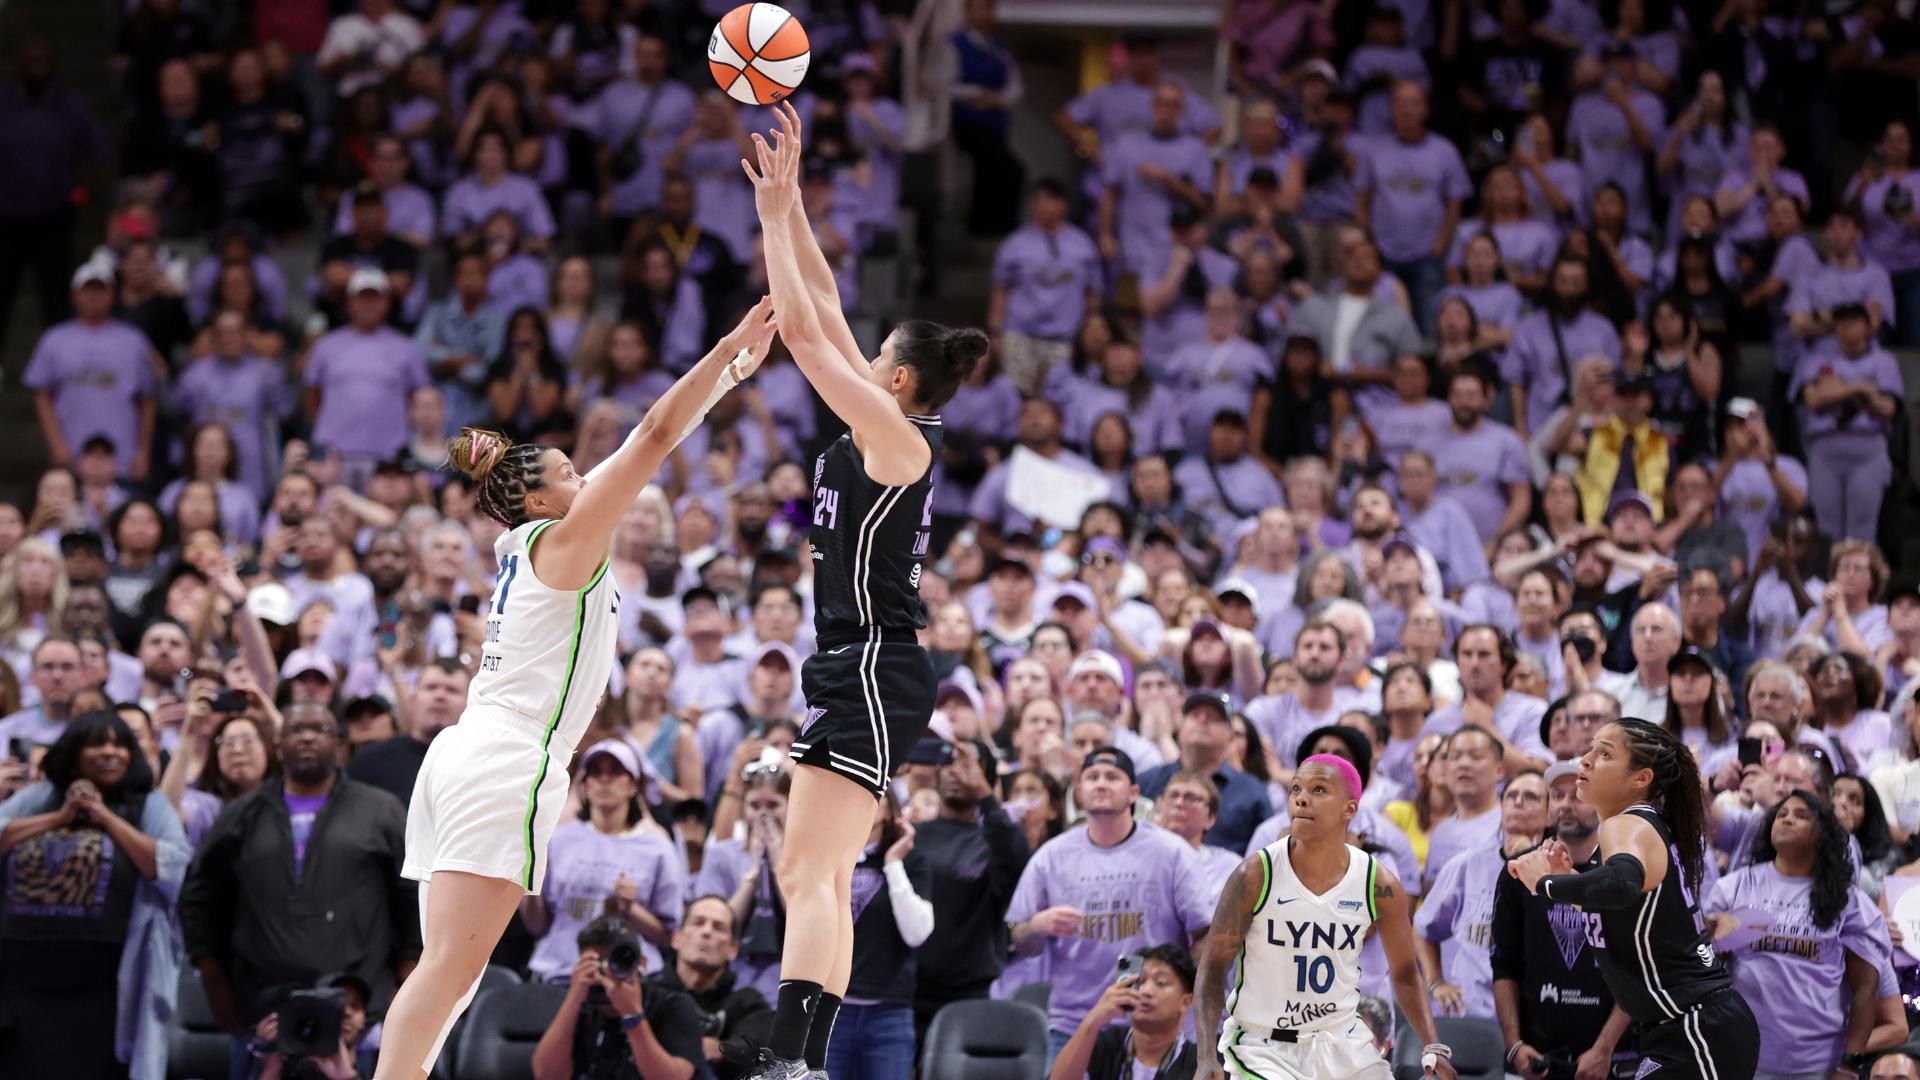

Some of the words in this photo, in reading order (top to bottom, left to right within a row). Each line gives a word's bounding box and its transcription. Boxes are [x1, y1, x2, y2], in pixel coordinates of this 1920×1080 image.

[813, 486, 839, 530] 24
[482, 655, 502, 671] AT&T
[1267, 919, 1361, 950] LYNX
[1581, 911, 1606, 948] 22
[1294, 955, 1335, 994] 10
